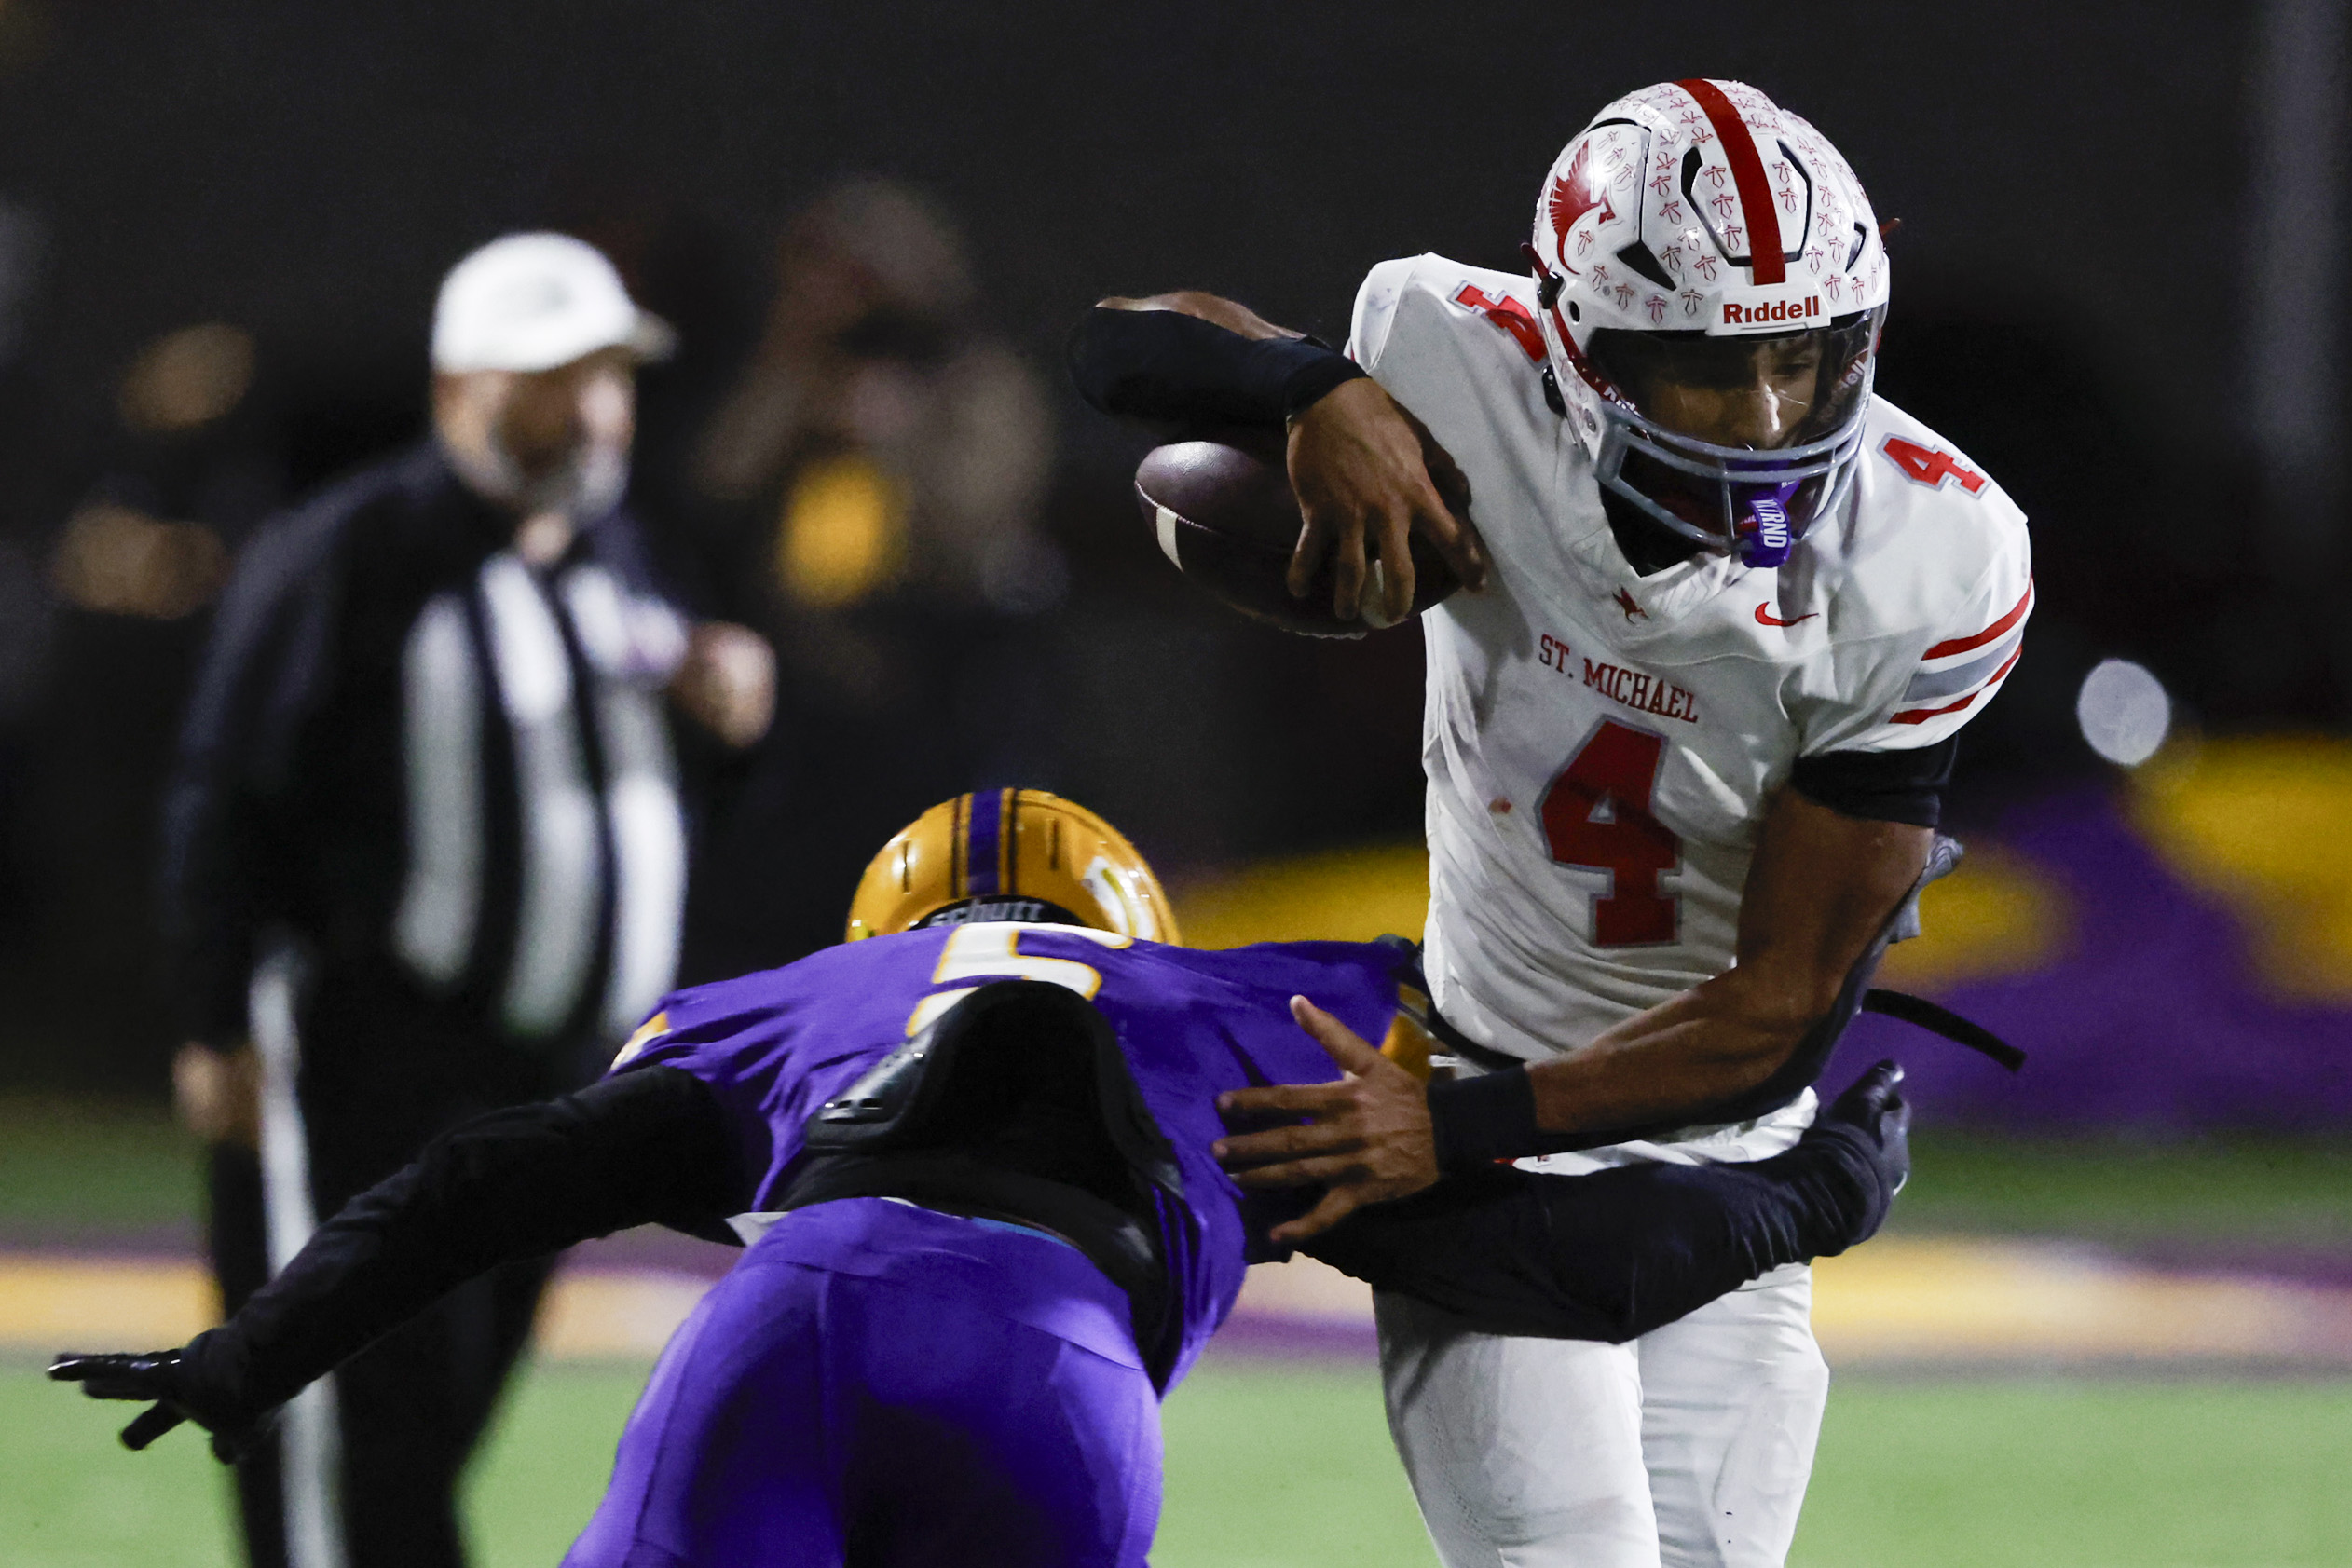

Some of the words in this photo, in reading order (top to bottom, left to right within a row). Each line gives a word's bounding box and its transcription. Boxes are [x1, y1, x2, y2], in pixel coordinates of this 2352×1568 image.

[1722, 295, 1820, 324] Riddell
[1875, 432, 1992, 500] 4
[1538, 634, 1574, 679] ST.
[1583, 657, 1699, 724] MICHAEL
[1533, 713, 1684, 948] 4
